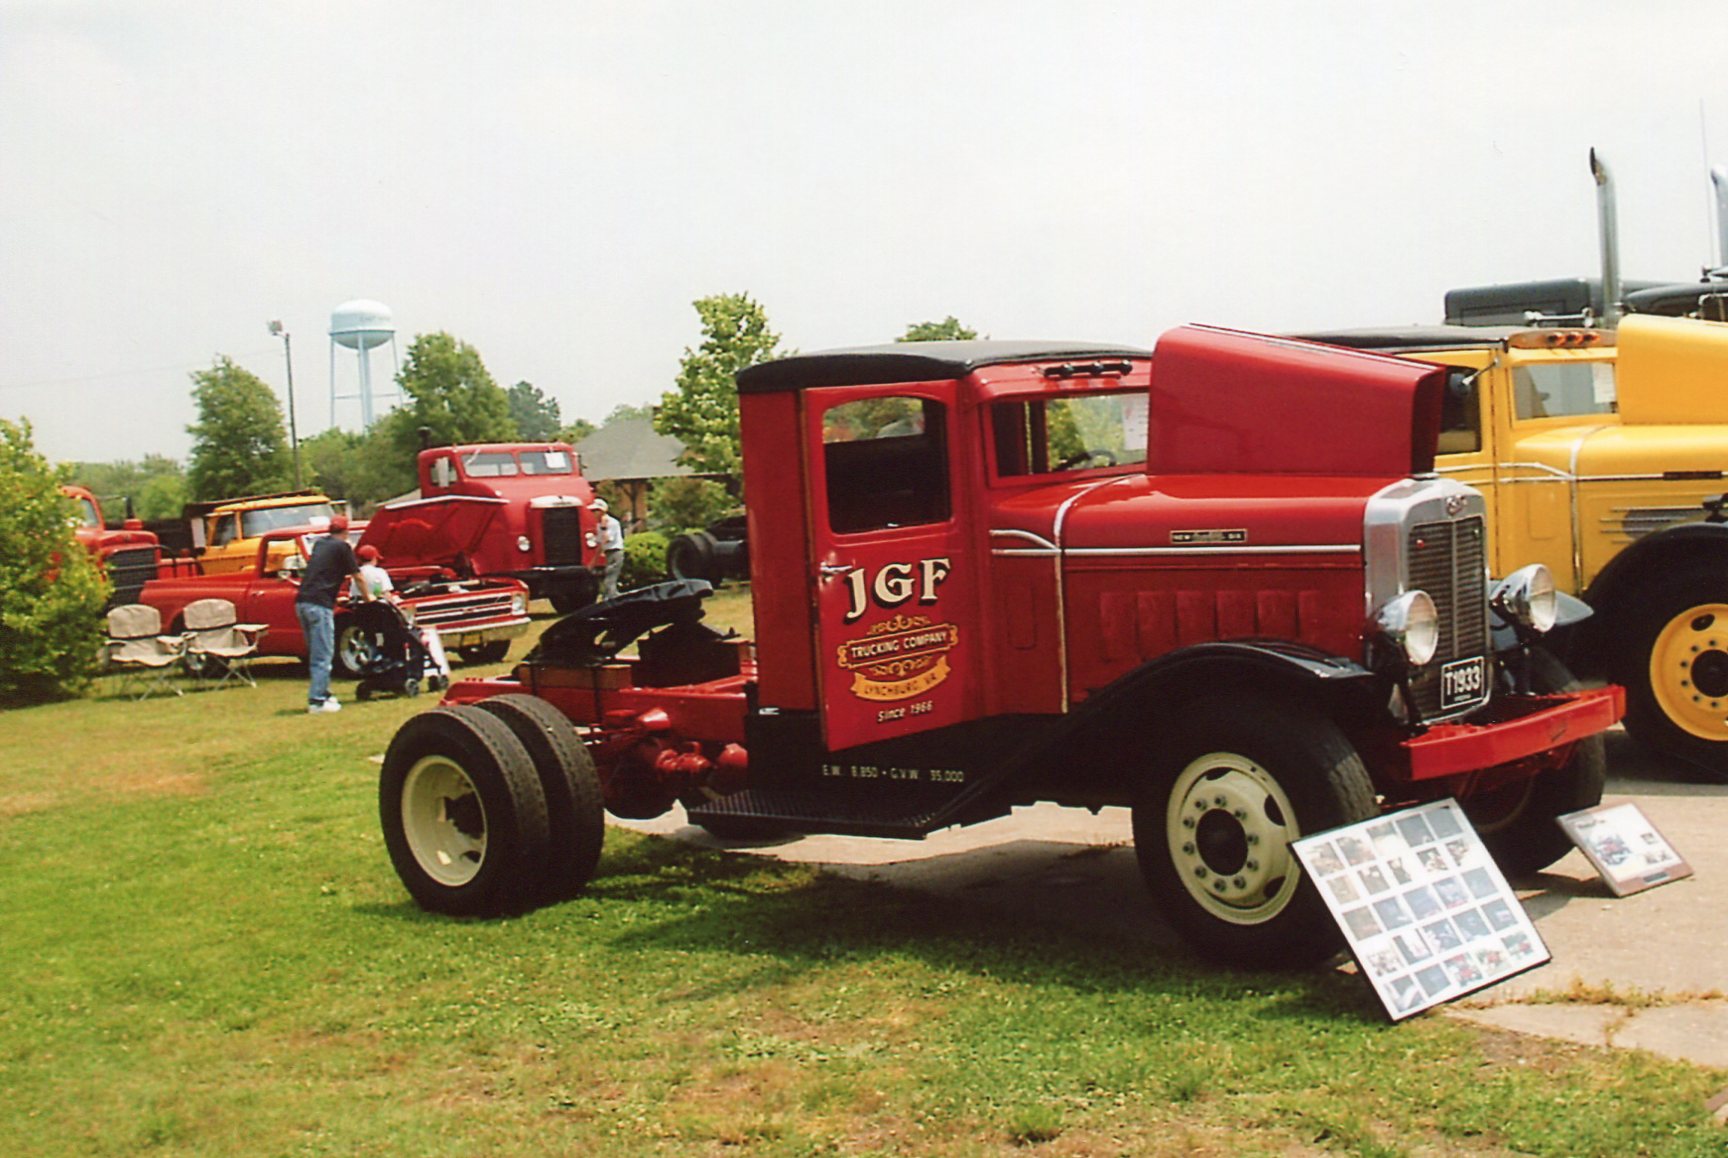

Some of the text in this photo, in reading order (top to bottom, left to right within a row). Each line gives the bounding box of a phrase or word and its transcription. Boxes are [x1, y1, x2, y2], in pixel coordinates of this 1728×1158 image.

[844, 557, 951, 623] JGF
[851, 631, 947, 659] TRUCKING COMPANY
[1445, 665, 1480, 696] T1933
[910, 700, 933, 715] 1966
